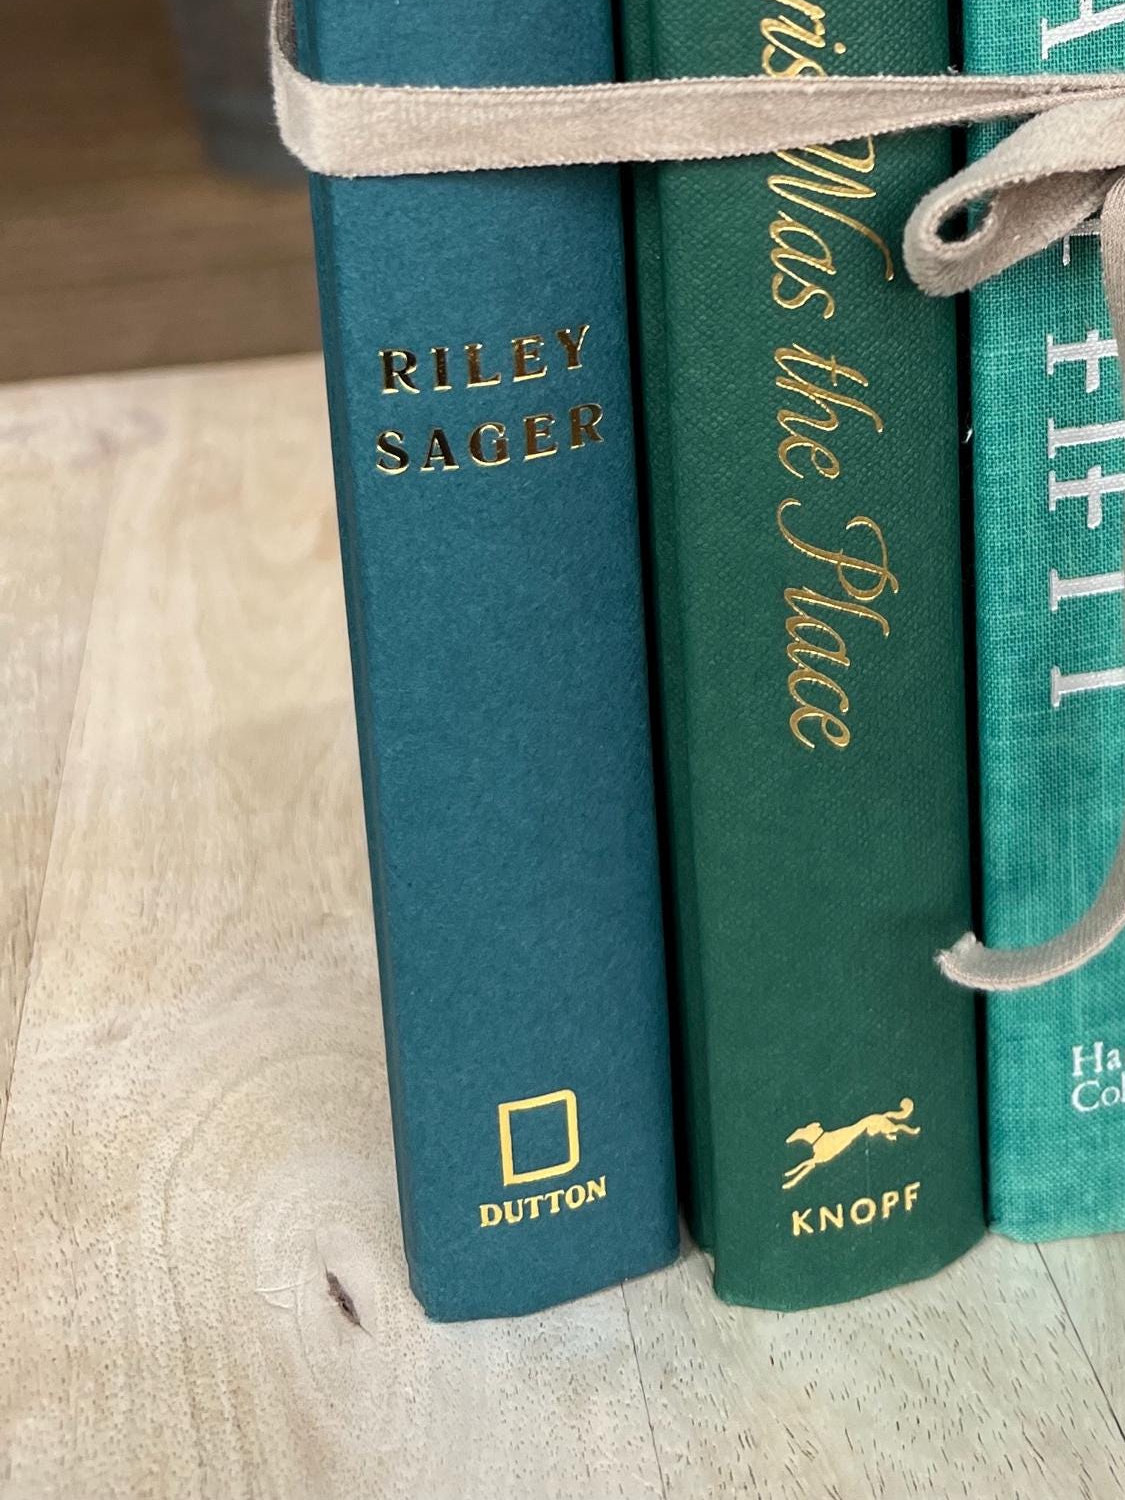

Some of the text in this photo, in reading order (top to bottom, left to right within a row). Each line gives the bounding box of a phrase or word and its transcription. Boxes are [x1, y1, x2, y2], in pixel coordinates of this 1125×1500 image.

[378, 324, 591, 394] RILEY
[376, 403, 604, 476] SAGER
[774, 342, 884, 480] the
[776, 498, 899, 750] Place
[479, 1175, 608, 1228] DUTTON
[790, 1182, 922, 1237] KNOPF
